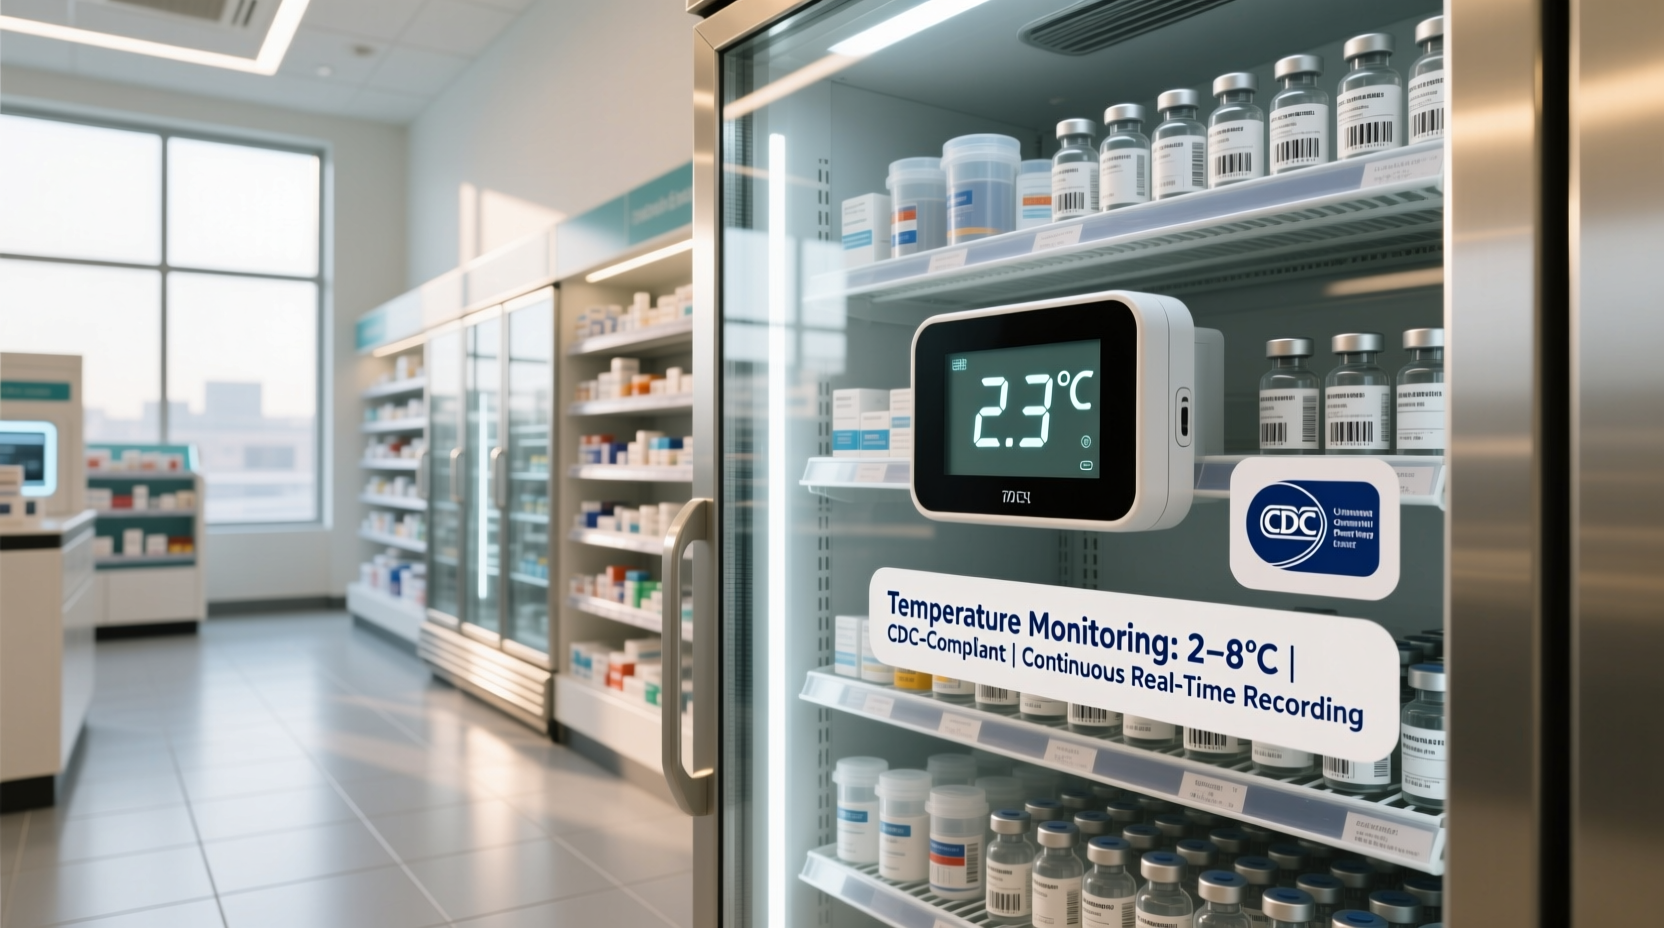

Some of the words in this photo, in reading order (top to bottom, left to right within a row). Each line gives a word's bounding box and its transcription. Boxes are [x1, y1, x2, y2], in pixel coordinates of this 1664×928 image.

[973, 370, 1094, 448] 2.3°C
[1264, 509, 1317, 536] CDC
[887, 590, 1022, 635] Temperature
[1029, 610, 1178, 666] Monitoring:
[1022, 646, 1125, 684] Continuous
[1131, 665, 1236, 705] Real-Time
[1243, 684, 1364, 733] Recording
